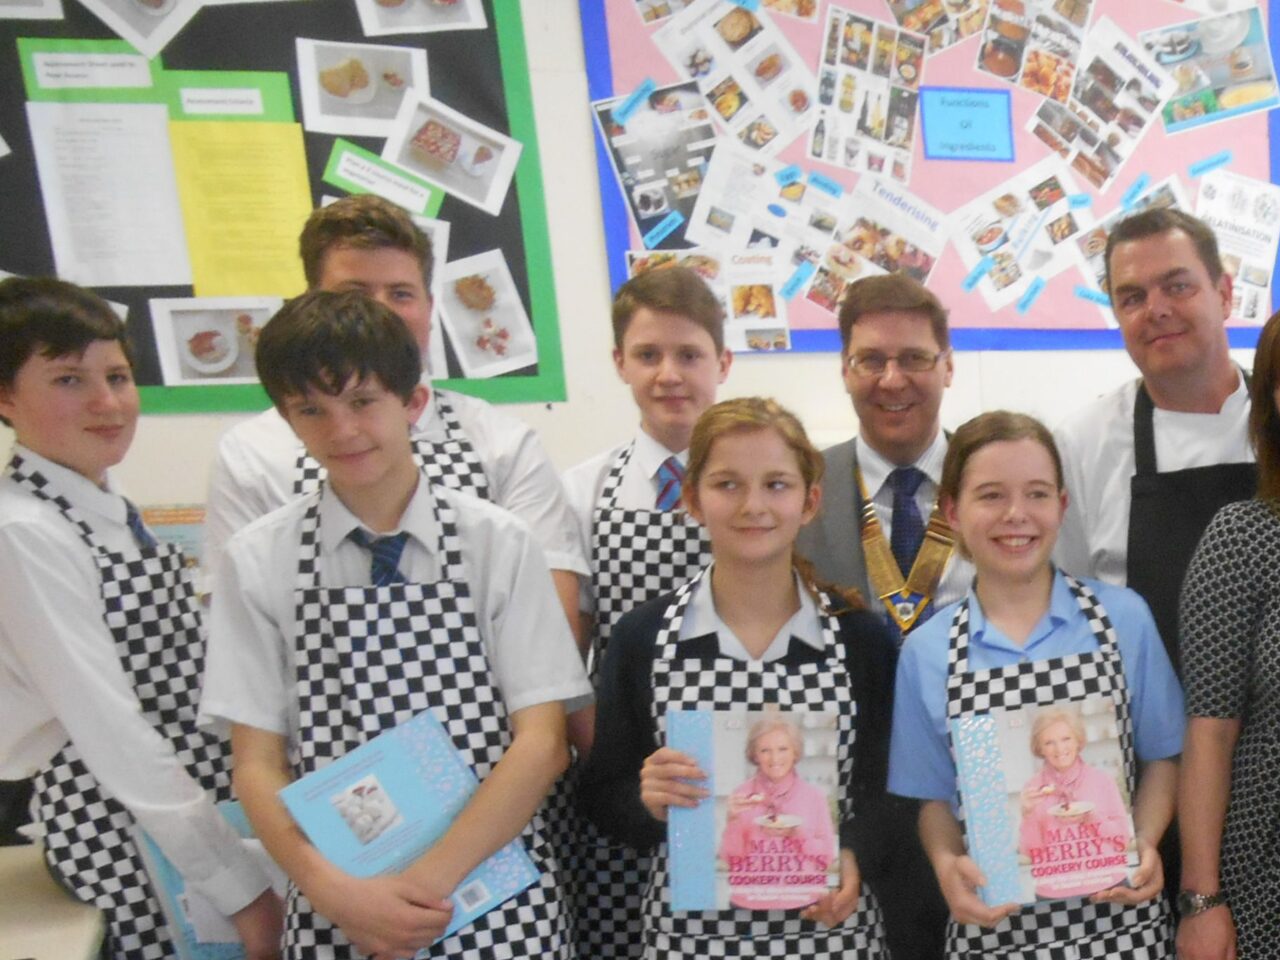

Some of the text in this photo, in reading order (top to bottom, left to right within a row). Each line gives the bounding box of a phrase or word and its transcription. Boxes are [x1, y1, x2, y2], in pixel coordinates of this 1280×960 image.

[872, 179, 941, 233] Tenderising
[1046, 821, 1102, 843] MARY
[750, 837, 805, 854] MARY
[1029, 835, 1126, 865] BERRY'S
[728, 854, 829, 873] BERRY'S
[1031, 854, 1128, 877] COOKERY COURSE
[728, 874, 828, 886] COOKERY COURSE
